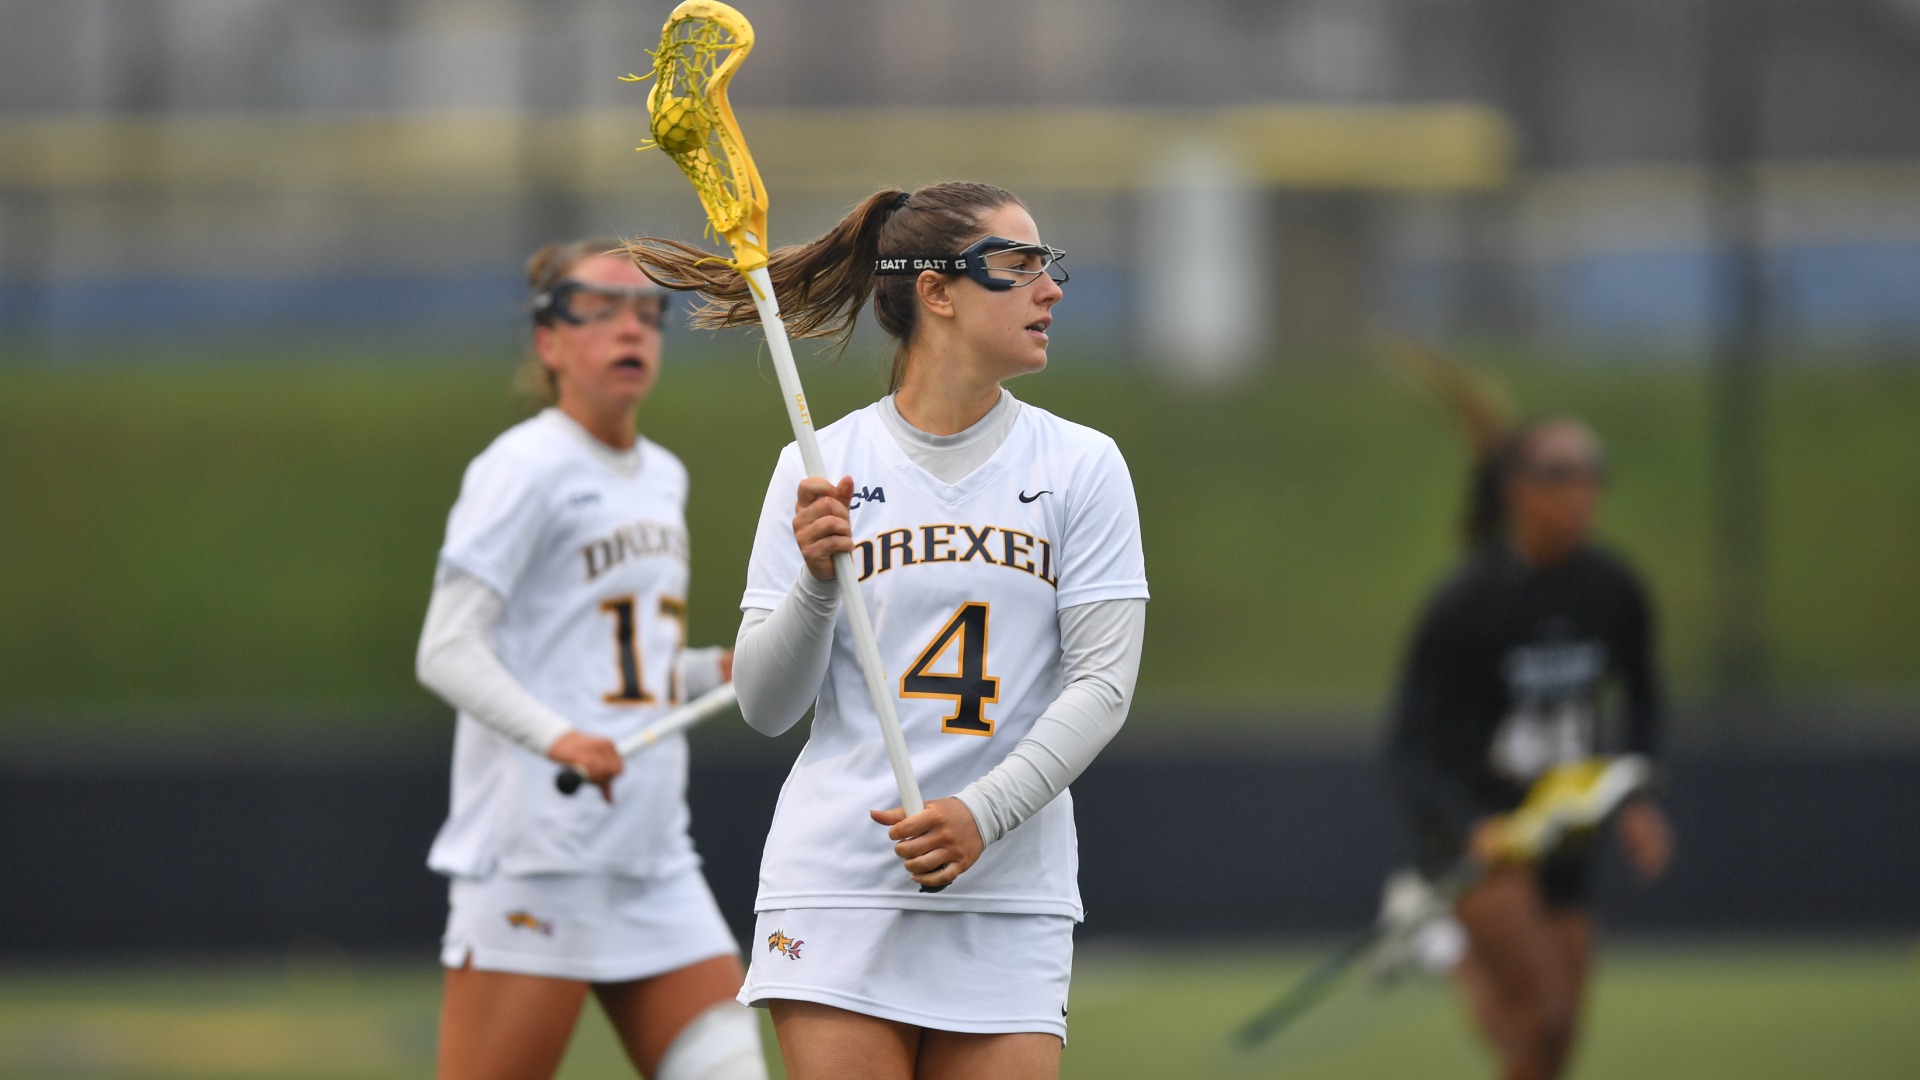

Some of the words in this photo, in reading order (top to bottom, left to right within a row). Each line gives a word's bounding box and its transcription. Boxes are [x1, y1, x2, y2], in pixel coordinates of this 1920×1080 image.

[881, 259, 907, 270] GAIT
[913, 259, 947, 270] GAIT
[796, 393, 810, 425] GAIT
[899, 601, 1000, 737] 4
